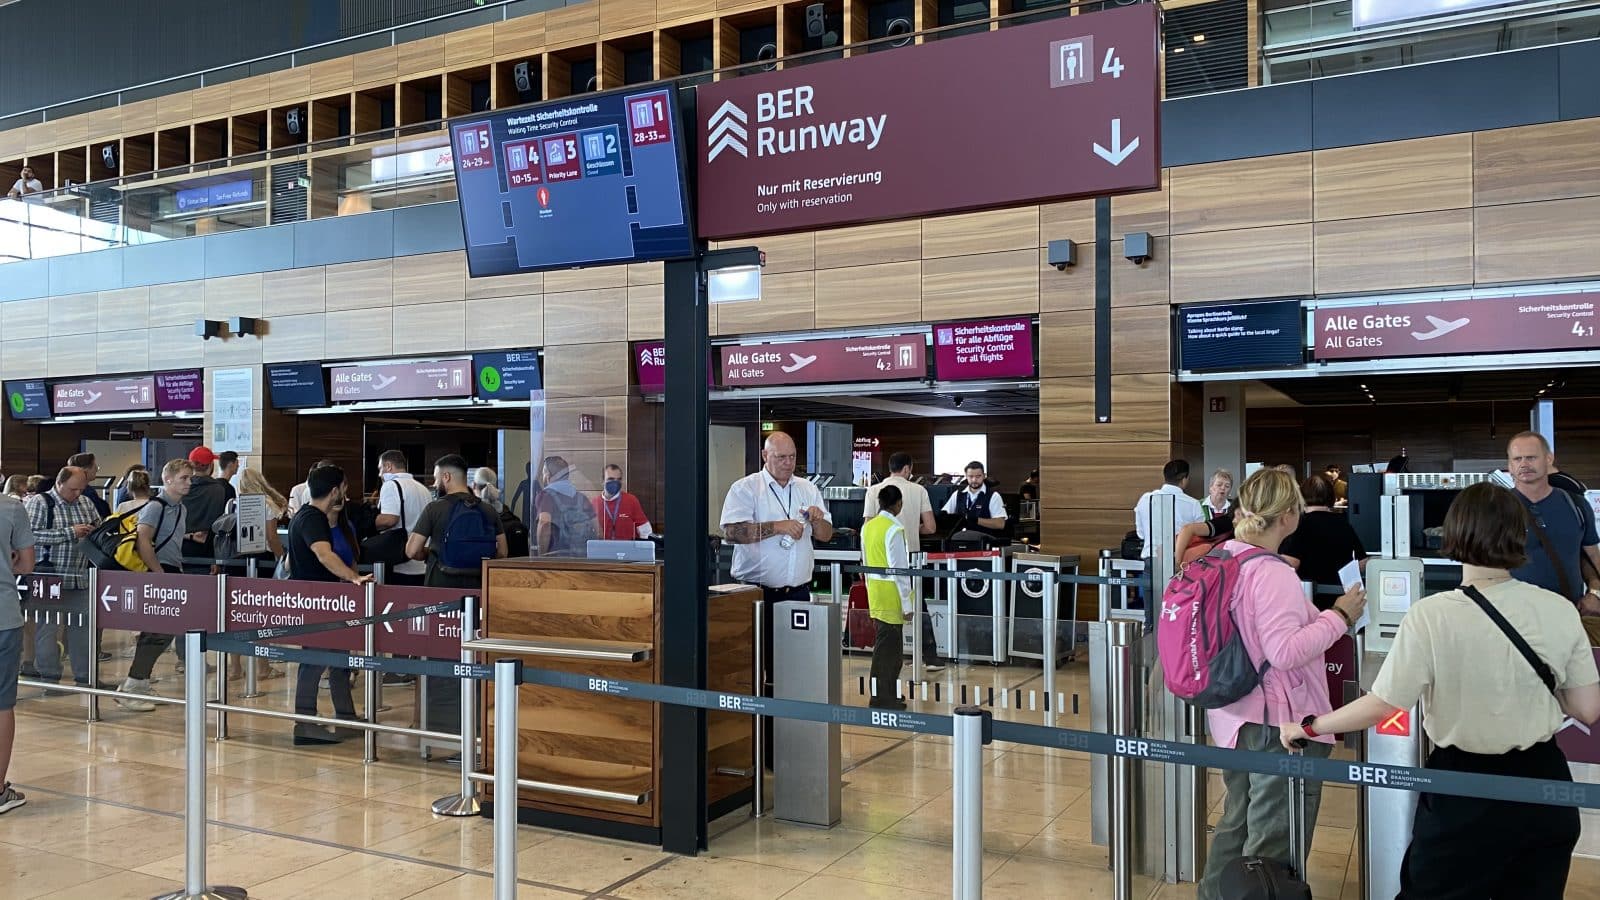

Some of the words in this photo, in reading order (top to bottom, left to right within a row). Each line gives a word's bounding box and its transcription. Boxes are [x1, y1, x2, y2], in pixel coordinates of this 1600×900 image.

[1101, 47, 1125, 78] 4
[757, 85, 814, 122] BER
[536, 104, 598, 121] Sicherheitskontrolle
[654, 101, 663, 121] 1
[508, 126, 526, 135] Waiting
[539, 122, 559, 130] Security
[560, 118, 578, 127] Control
[479, 131, 489, 148] 5
[634, 131, 657, 143] 28-33
[757, 114, 887, 157] Runway
[566, 140, 576, 159] 3
[605, 134, 616, 154] 2
[529, 146, 539, 164] 4
[462, 157, 483, 168] 24-29
[512, 174, 531, 184] 10-15
[757, 185, 778, 196] Nur
[782, 180, 800, 193] mit
[804, 171, 882, 190] Reservierung
[757, 203, 777, 214] Only
[780, 198, 799, 209] with
[802, 193, 853, 207] reservation
[1519, 303, 1594, 313] Sicherheitskontrolle
[955, 323, 1025, 335] Sicherheitskontrolle
[1325, 316, 1357, 332] Alle
[1363, 314, 1411, 329] Gates
[1571, 321, 1593, 336] 4.1
[956, 336, 966, 344] für
[969, 336, 981, 344] alle
[983, 334, 1013, 343] Abflüge
[1325, 337, 1342, 348] All
[1346, 336, 1383, 347] Gates
[653, 348, 665, 357] BE
[956, 344, 985, 354] Security
[987, 342, 1014, 352] Control
[506, 353, 520, 362] BER
[728, 353, 749, 365] Alle
[751, 352, 781, 363] Gates
[876, 358, 891, 371] 4.2
[957, 355, 967, 363] for
[969, 354, 978, 362] all
[980, 353, 1004, 363] flights
[335, 374, 350, 383] Alle
[351, 372, 372, 382] Gates
[728, 369, 739, 379] All
[741, 368, 764, 378] Gates
[57, 390, 68, 398] Alle
[69, 389, 84, 397] Gates
[344, 386, 360, 394] Gates
[143, 584, 187, 605] Eingang
[231, 590, 356, 613] Sicherheitskontrolle
[143, 603, 180, 617] Entrance
[424, 605, 436, 614] BER
[231, 609, 267, 627] Security
[270, 612, 304, 626] control
[257, 629, 273, 638] BER
[254, 646, 269, 657] BER
[349, 657, 364, 667] BER
[454, 665, 472, 676] BER
[589, 678, 608, 692] BER
[719, 695, 741, 709] BER
[871, 711, 897, 727] BER
[1115, 738, 1149, 756] BER
[1348, 765, 1387, 784] BER
